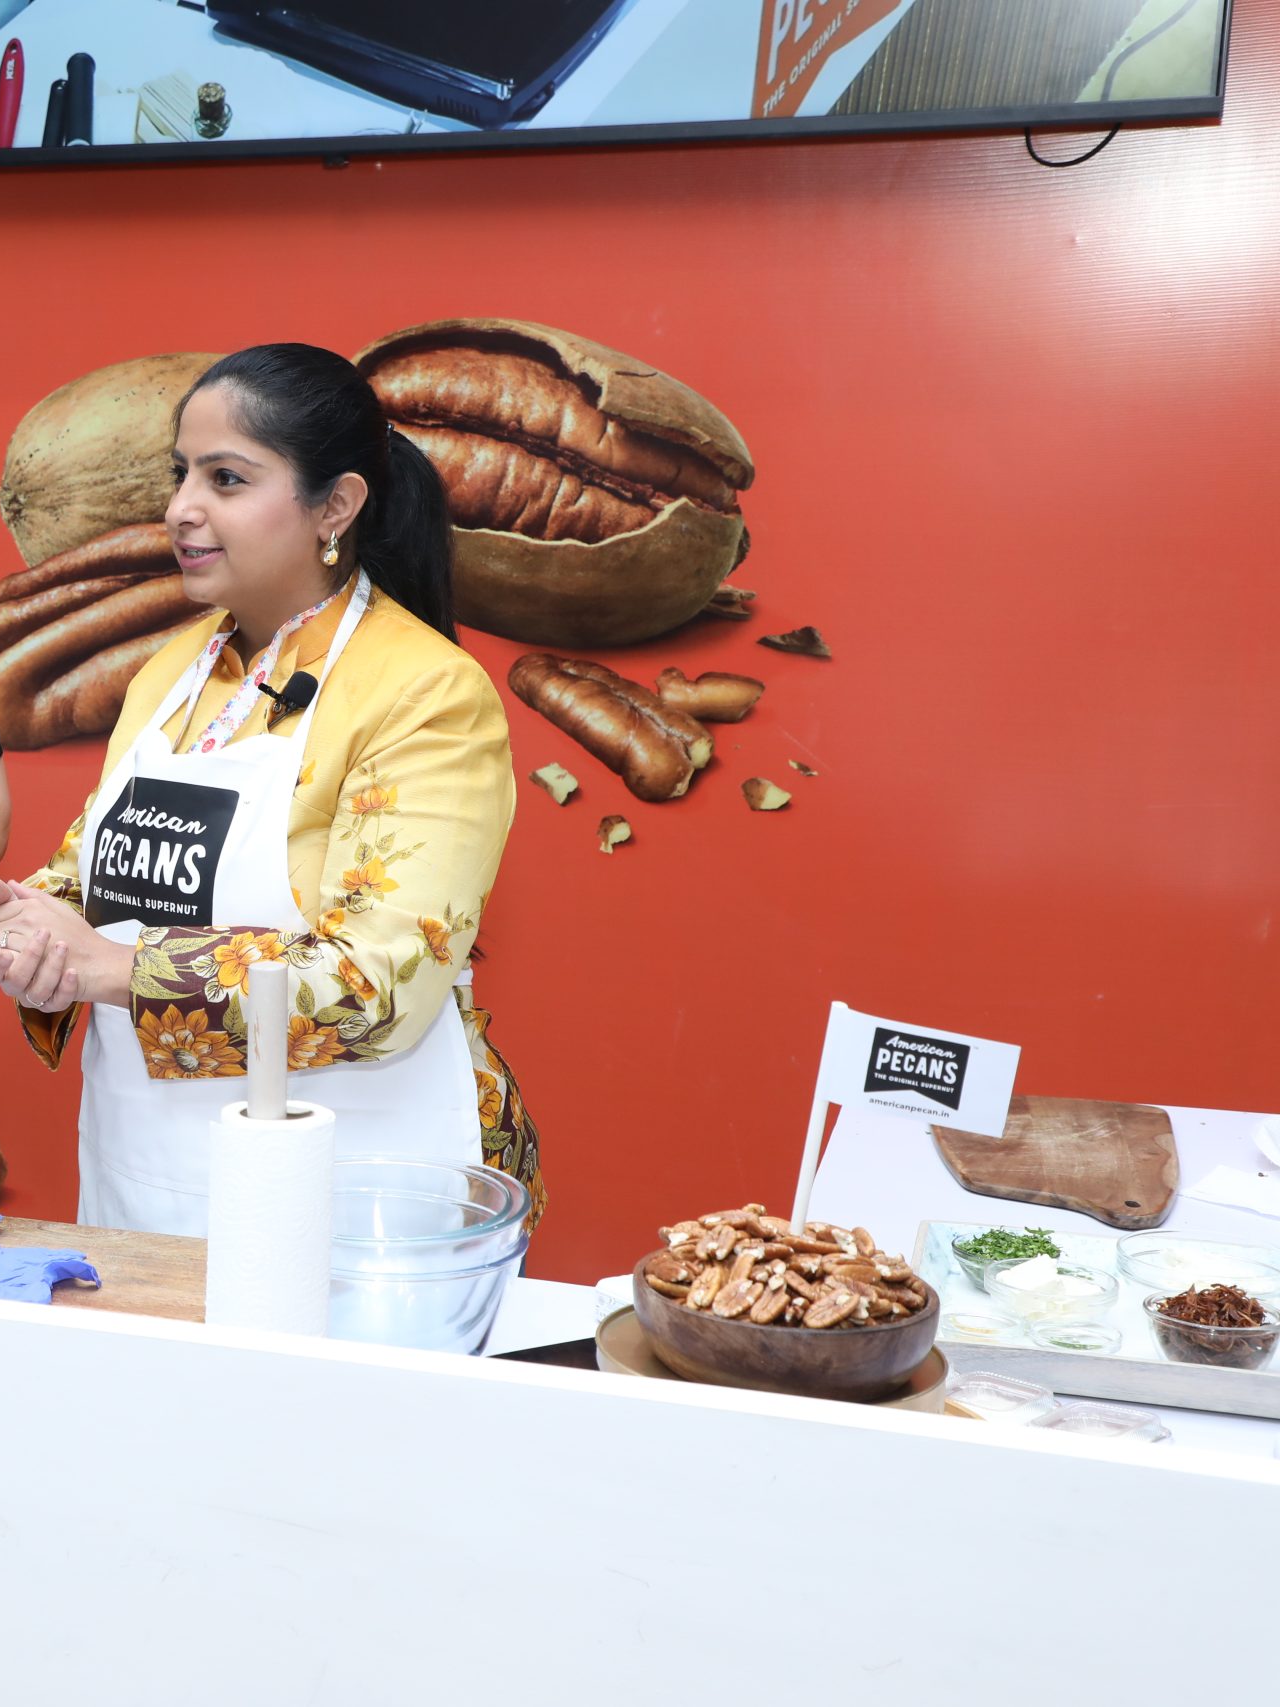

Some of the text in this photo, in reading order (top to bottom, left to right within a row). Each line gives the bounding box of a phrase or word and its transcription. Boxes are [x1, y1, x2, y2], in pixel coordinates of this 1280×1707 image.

[789, 12, 843, 85] ORIGINAL
[95, 828, 207, 895] PECANS
[93, 885, 198, 916] THE ORIGINAL SUPERNUT
[885, 1035, 957, 1059] American
[875, 1047, 959, 1085] PECANS
[874, 1072, 955, 1093] THE ORIGINAL SUPERNUT
[869, 1097, 950, 1118] americanpecan.in
